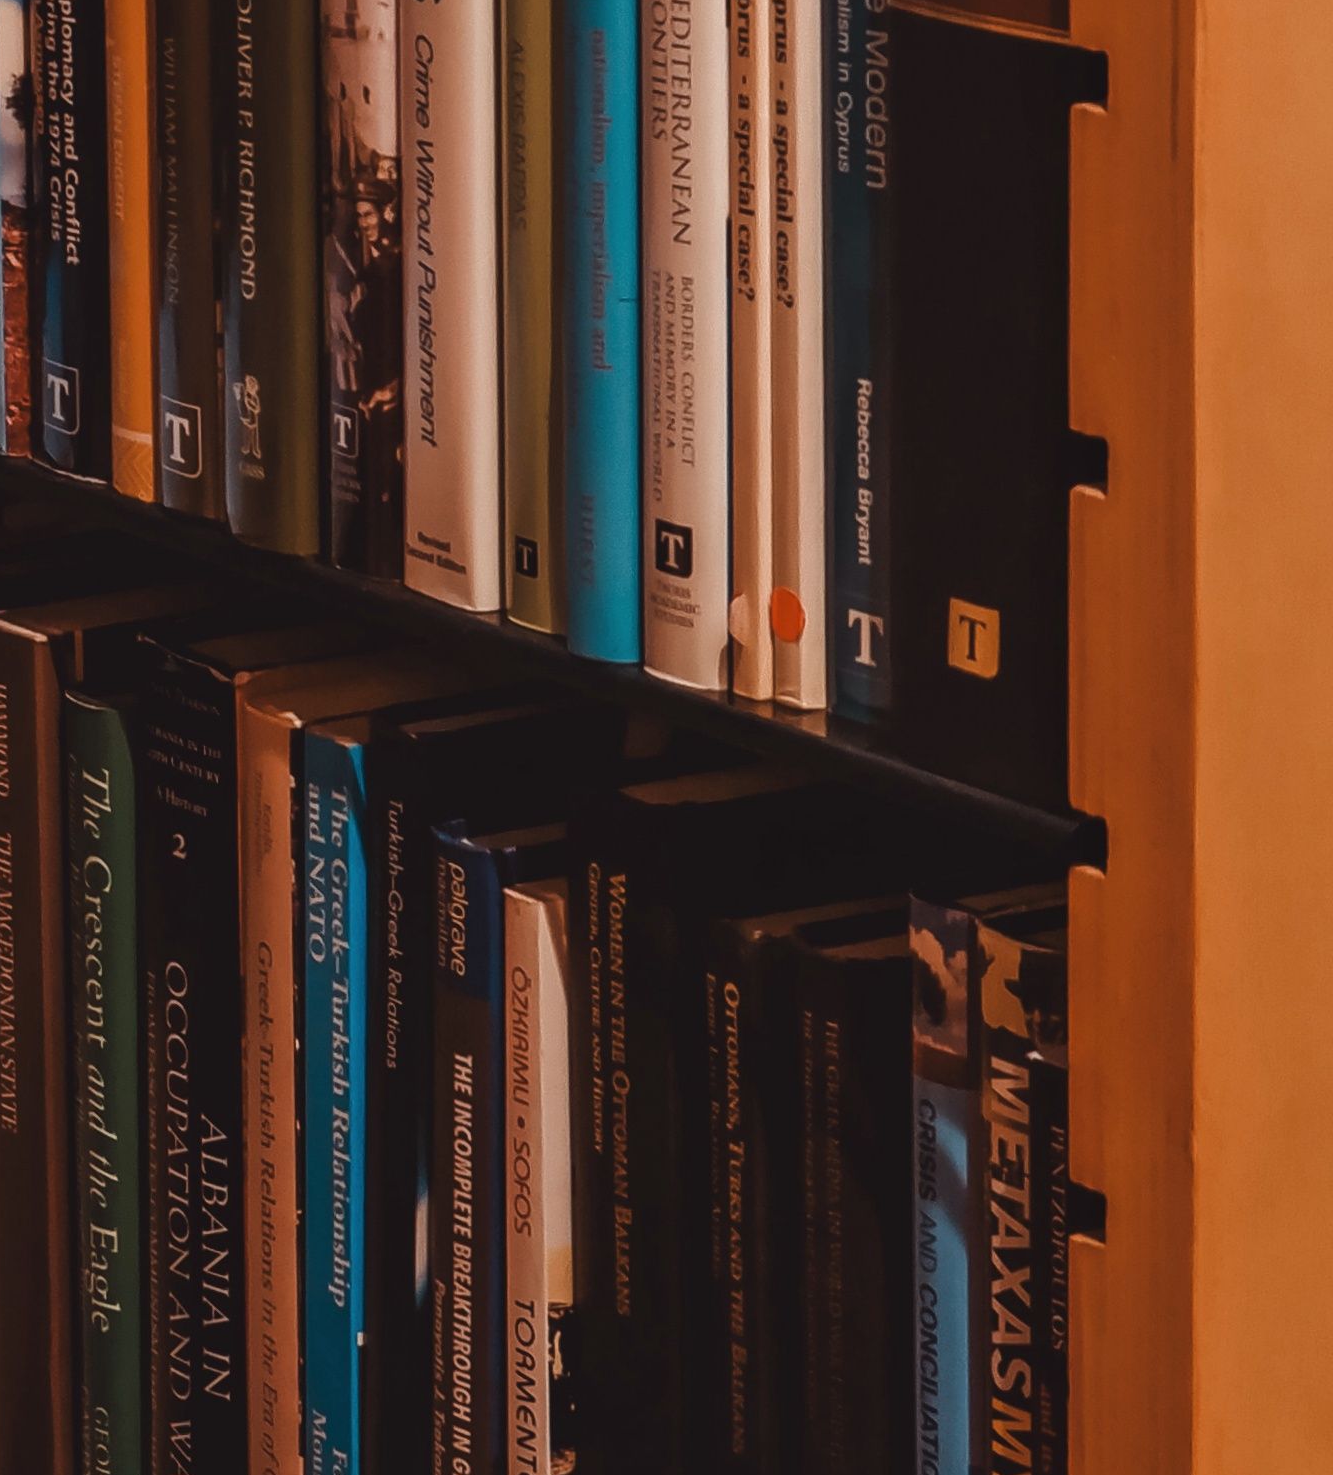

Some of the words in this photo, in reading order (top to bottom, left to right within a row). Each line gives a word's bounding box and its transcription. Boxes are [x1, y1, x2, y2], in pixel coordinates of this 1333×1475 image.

[46, 59, 60, 103] the
[414, 34, 434, 129] Crime
[48, 112, 61, 168] 1974
[63, 113, 78, 165] and
[49, 176, 63, 241] Crisis
[64, 169, 81, 265] Conflict
[415, 138, 437, 256] Without
[417, 262, 439, 447] Punishment
[856, 378, 872, 479] Rebecca
[854, 489, 874, 565] Bryant
[81, 767, 112, 838] The
[308, 783, 326, 842] and
[329, 786, 350, 847] The
[308, 852, 326, 961] NATO
[84, 855, 113, 1048] Crescent
[87, 1065, 116, 1140] and
[454, 1053, 473, 1096] THE
[87, 1151, 118, 1207] the
[332, 1106, 349, 1306] Relationship
[453, 1099, 472, 1238] INCOMPLETE
[85, 1223, 122, 1333] Eagle
[454, 1242, 472, 1420] BREAKTHROUGH
[451, 1426, 472, 1451] IN
